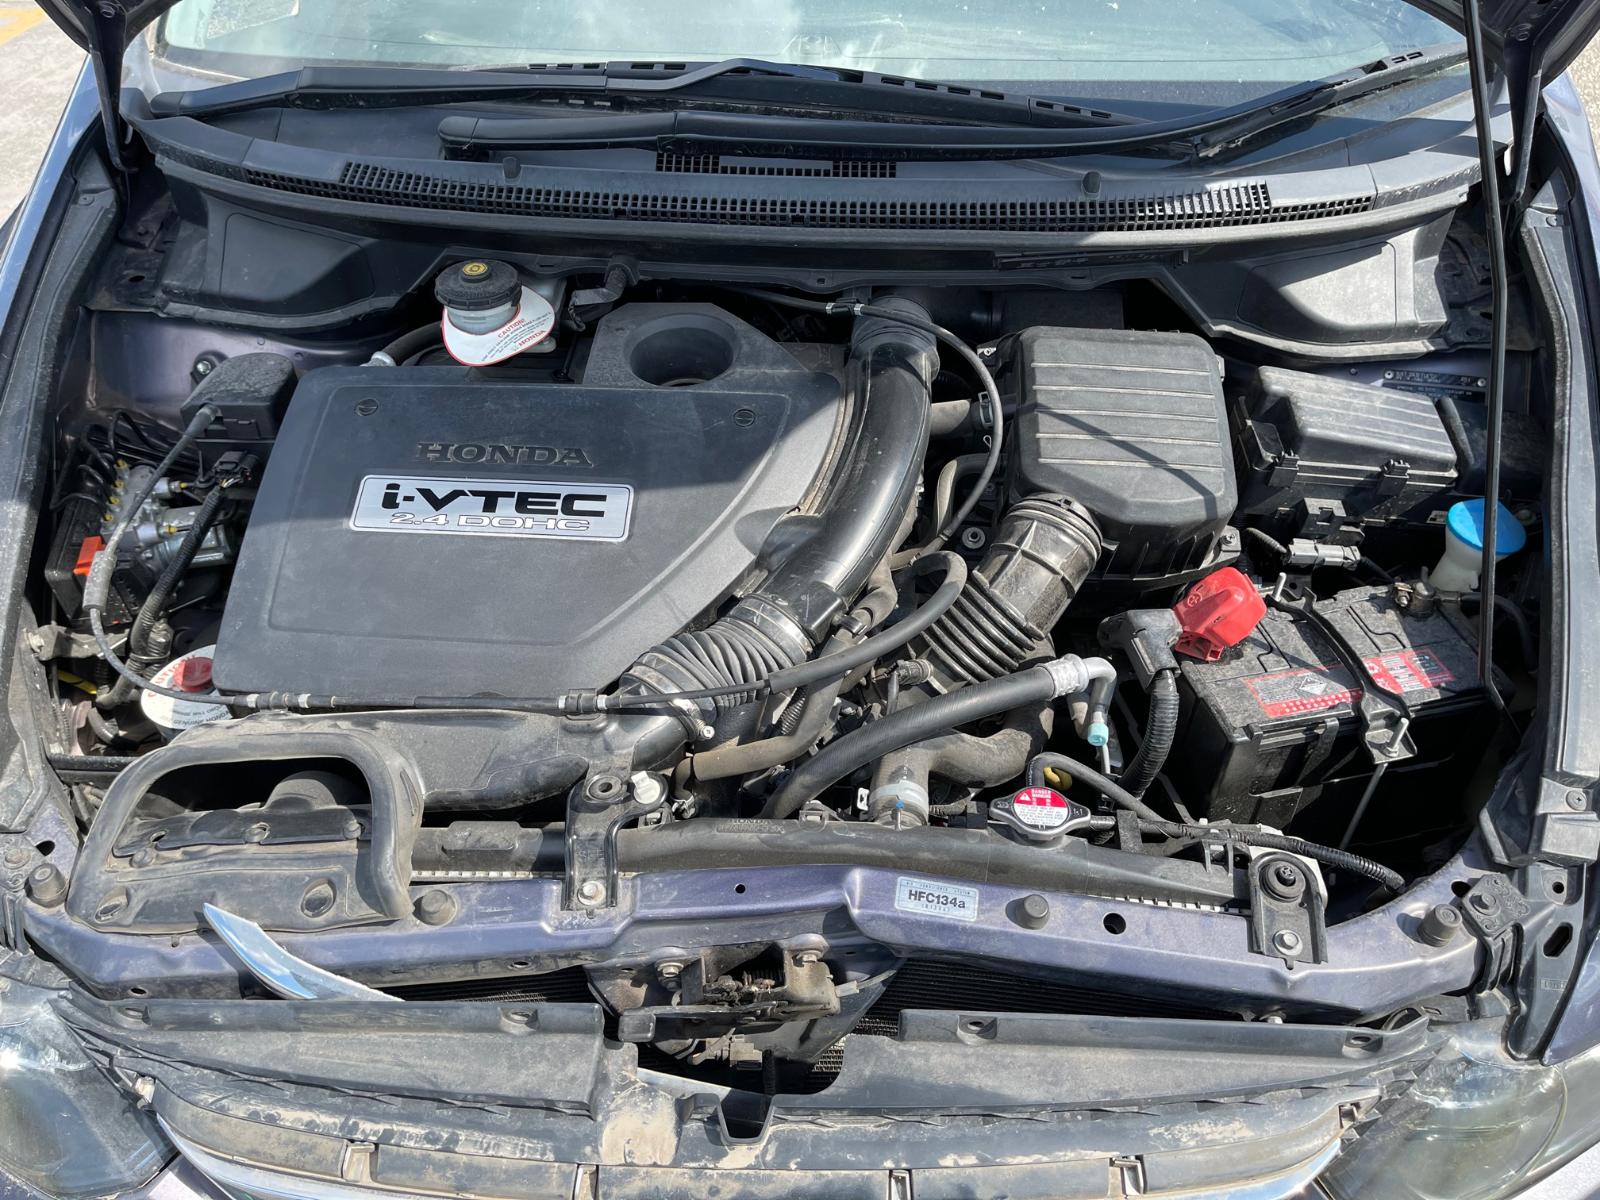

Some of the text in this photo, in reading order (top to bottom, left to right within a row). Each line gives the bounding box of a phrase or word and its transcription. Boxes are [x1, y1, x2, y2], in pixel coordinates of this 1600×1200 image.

[415, 441, 595, 468] HONDA
[381, 482, 608, 518] i-VTEC
[389, 512, 591, 532] 2.4 DOHC
[908, 889, 966, 909] HFC134a
